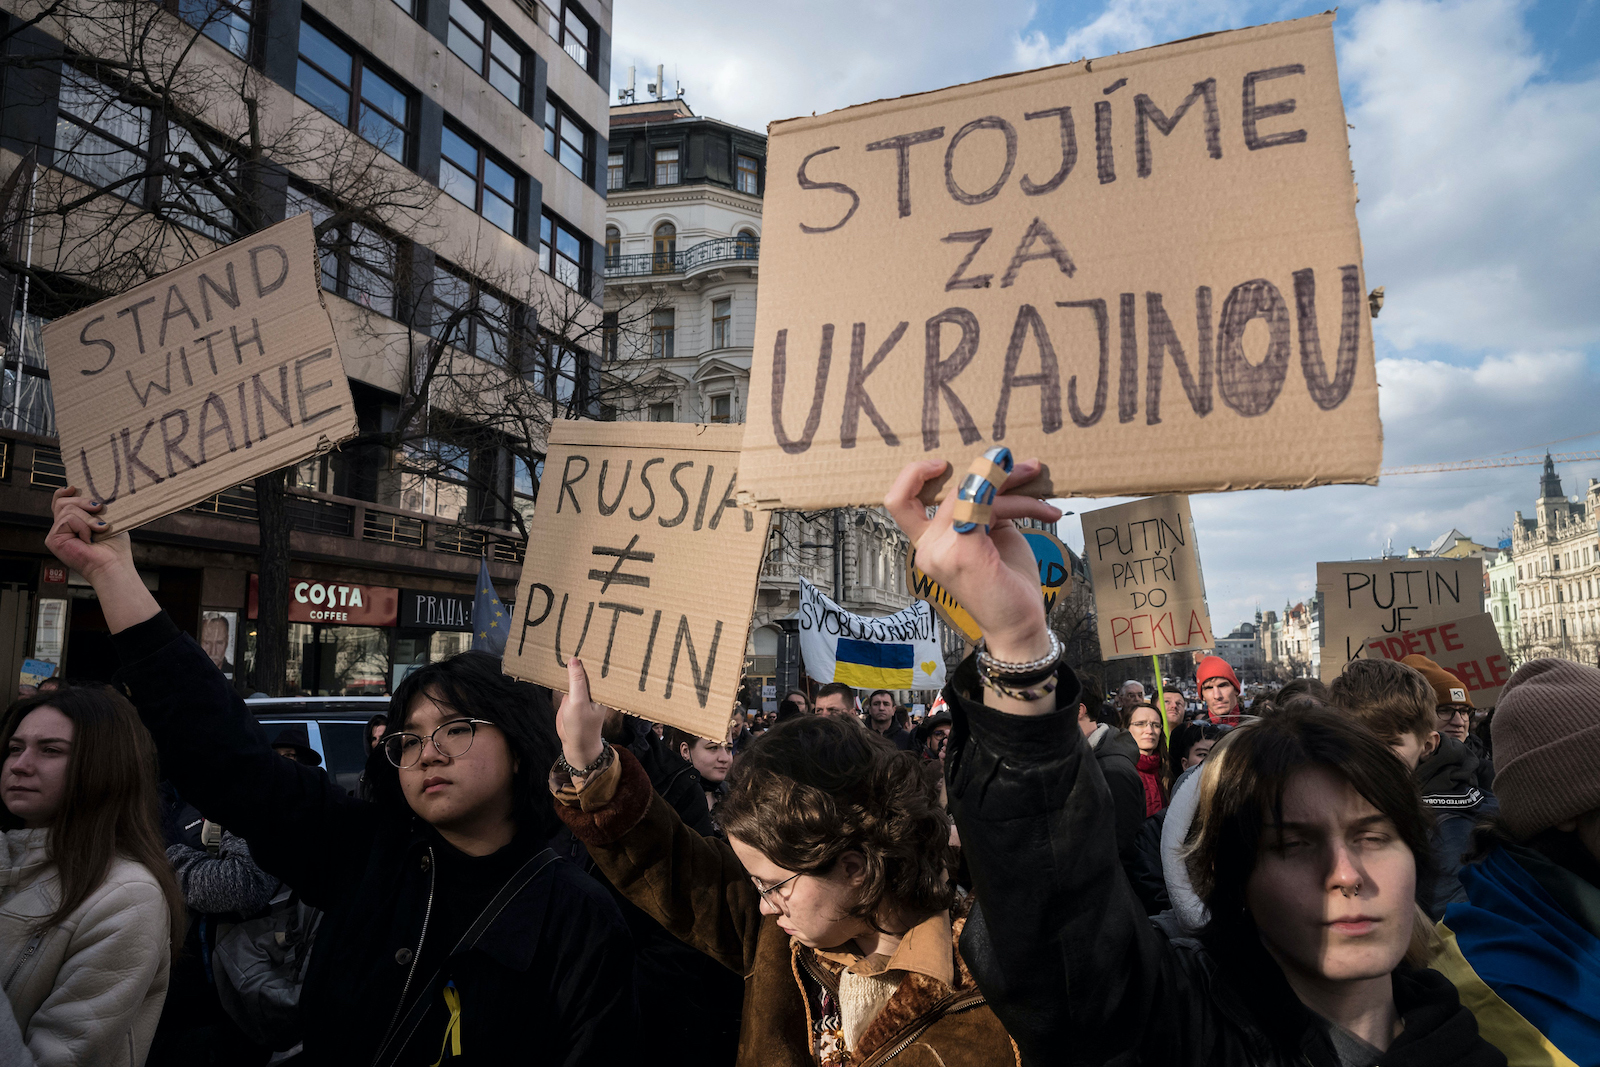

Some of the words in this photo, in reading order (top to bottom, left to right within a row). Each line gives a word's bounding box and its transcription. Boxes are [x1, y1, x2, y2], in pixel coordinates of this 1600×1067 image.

[797, 63, 1308, 234] STOJÍME
[940, 217, 1078, 292] ZA
[79, 243, 289, 376] STAND
[125, 317, 266, 408] WITH
[771, 265, 1360, 454] UKRAJINOU
[80, 347, 343, 505] UKRAINE
[556, 455, 754, 532] RUSSIA
[1095, 513, 1185, 561] PUTIN
[1111, 546, 1177, 590] PATŘÍ
[294, 581, 363, 609] COSTA
[310, 610, 348, 621] COFFEE
[1130, 588, 1168, 610] DO
[1342, 569, 1460, 609] PUTIN
[518, 582, 724, 709] PUTIN
[1110, 609, 1208, 654] PEKLA
